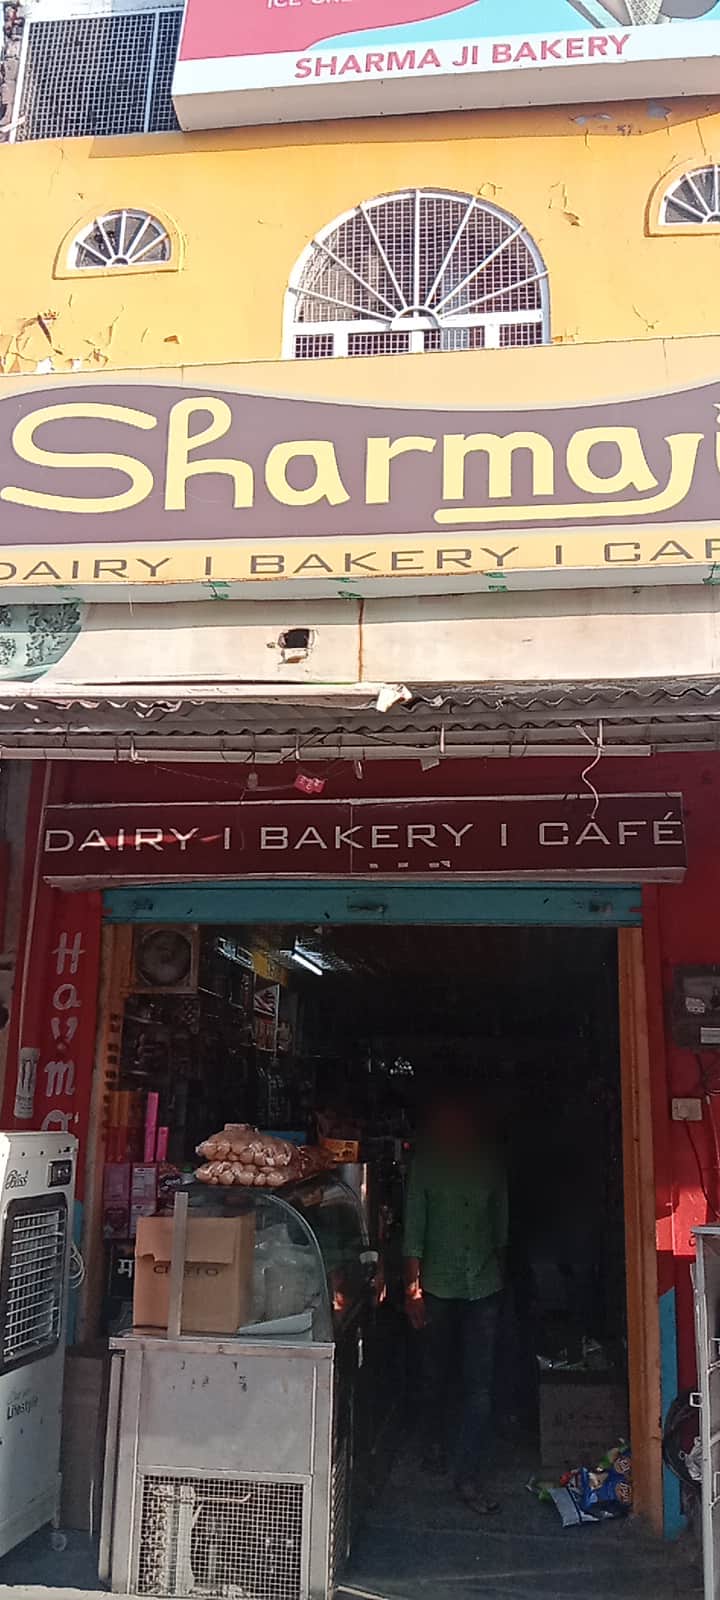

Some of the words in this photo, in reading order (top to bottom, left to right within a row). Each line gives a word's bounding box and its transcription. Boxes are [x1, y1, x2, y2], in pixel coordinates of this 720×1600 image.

[294, 48, 441, 79] SHARMA
[453, 48, 478, 66] JI
[491, 33, 631, 64] BAKERY
[0, 396, 720, 524] Sharmaj
[250, 546, 519, 575] BAKERY
[45, 827, 200, 852] DAIRY
[260, 823, 473, 850] BAKERY
[538, 811, 683, 846] CAFÉ
